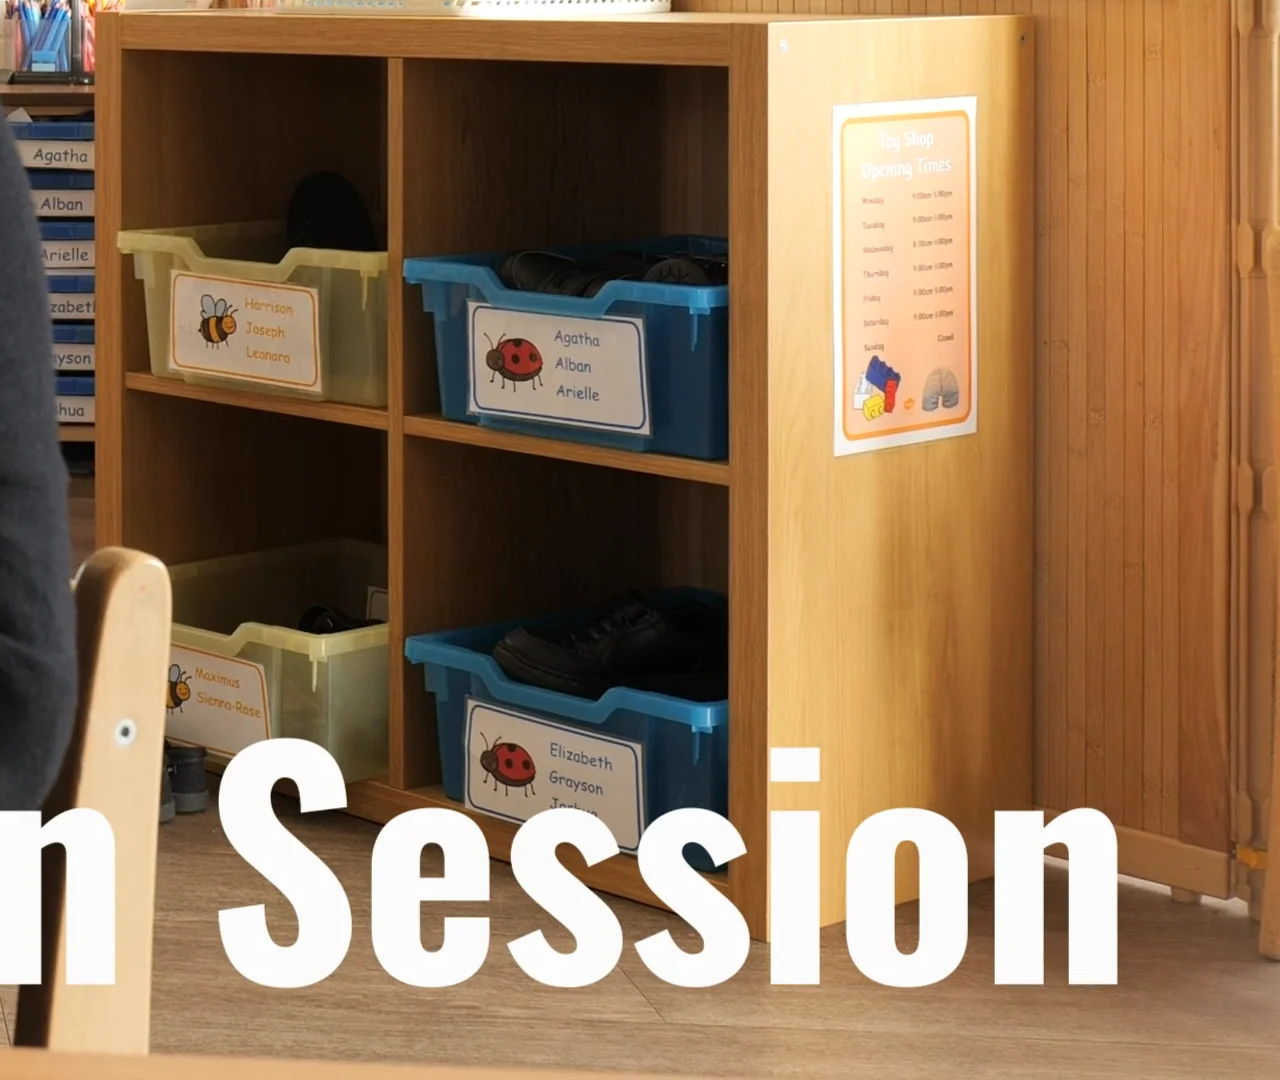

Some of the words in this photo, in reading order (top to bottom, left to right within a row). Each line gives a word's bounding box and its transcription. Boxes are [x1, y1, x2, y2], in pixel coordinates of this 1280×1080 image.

[879, 131, 900, 153] Toy
[904, 130, 934, 150] Shop
[33, 148, 88, 165] Agatha
[860, 161, 913, 182] Opening
[916, 156, 952, 174] Times
[41, 197, 83, 211] Alban
[40, 248, 89, 261] Arielle
[50, 300, 95, 313] zabet
[244, 297, 293, 315] Harrison
[245, 321, 285, 341] Joseph
[554, 330, 600, 348] Agatha
[54, 354, 91, 367] yson
[246, 345, 291, 364] Leonora
[555, 357, 592, 373] Alban
[556, 385, 600, 401] Arielle
[57, 403, 85, 417] hua
[195, 667, 240, 688] Maximus
[196, 691, 262, 719] Sienna-Rose
[550, 742, 613, 771] Elizabeth
[549, 770, 603, 796] Grayson
